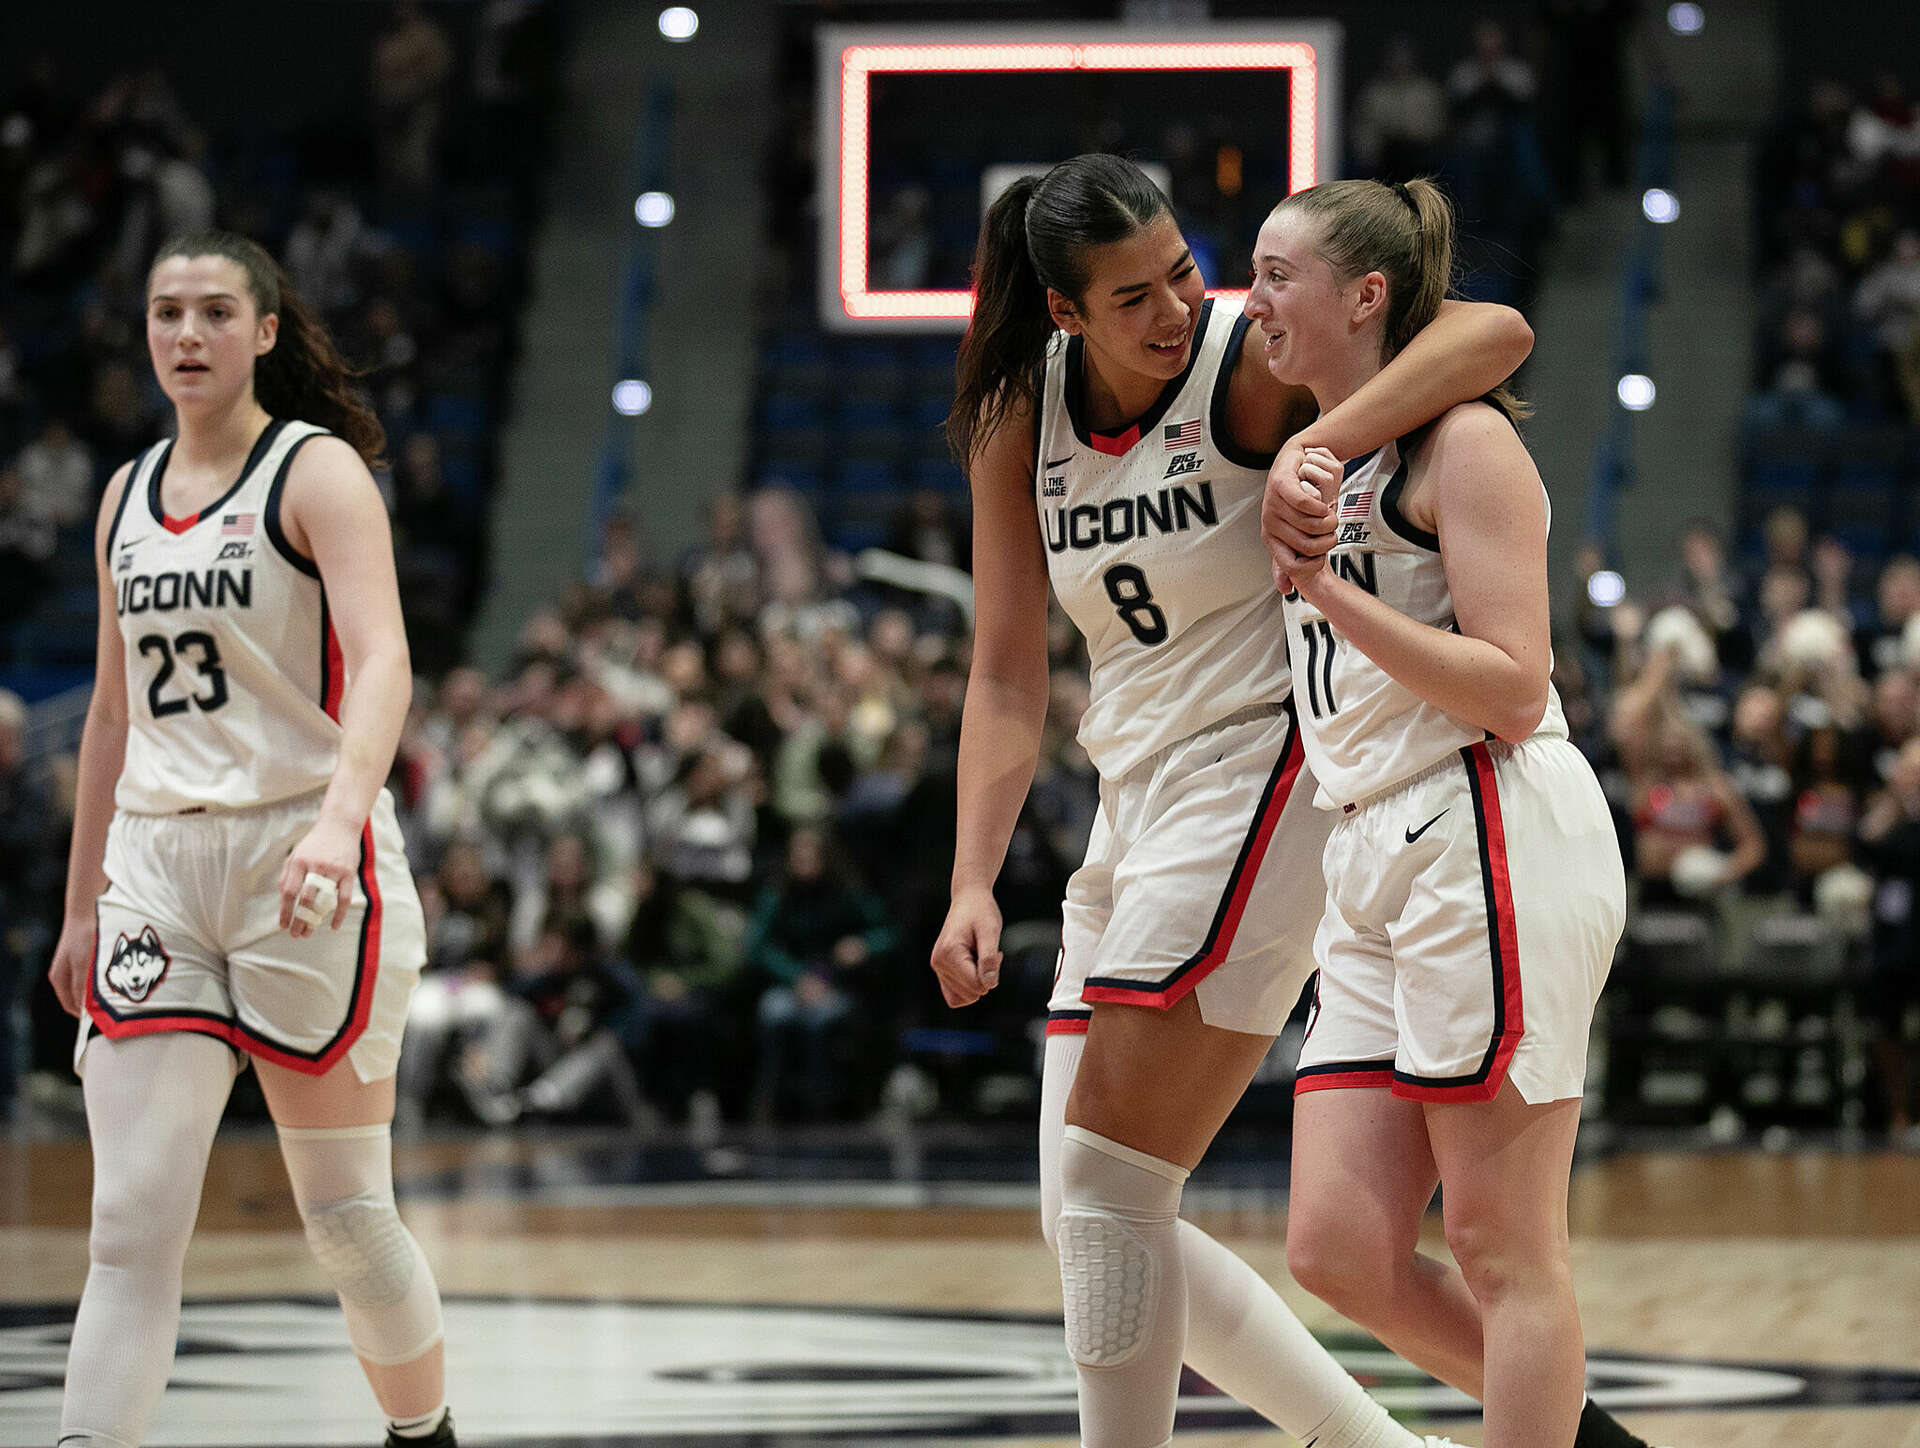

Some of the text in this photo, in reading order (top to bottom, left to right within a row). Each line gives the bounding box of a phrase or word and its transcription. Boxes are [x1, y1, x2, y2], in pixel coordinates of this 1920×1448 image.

[1170, 452, 1197, 465] BIG
[1166, 459, 1204, 474] EAST
[1048, 477, 1065, 488] THE
[1343, 522, 1365, 533] BIG
[1339, 531, 1371, 542] EAST
[1103, 562, 1169, 646] 8
[138, 631, 230, 719] 23
[1301, 620, 1339, 719] 11
